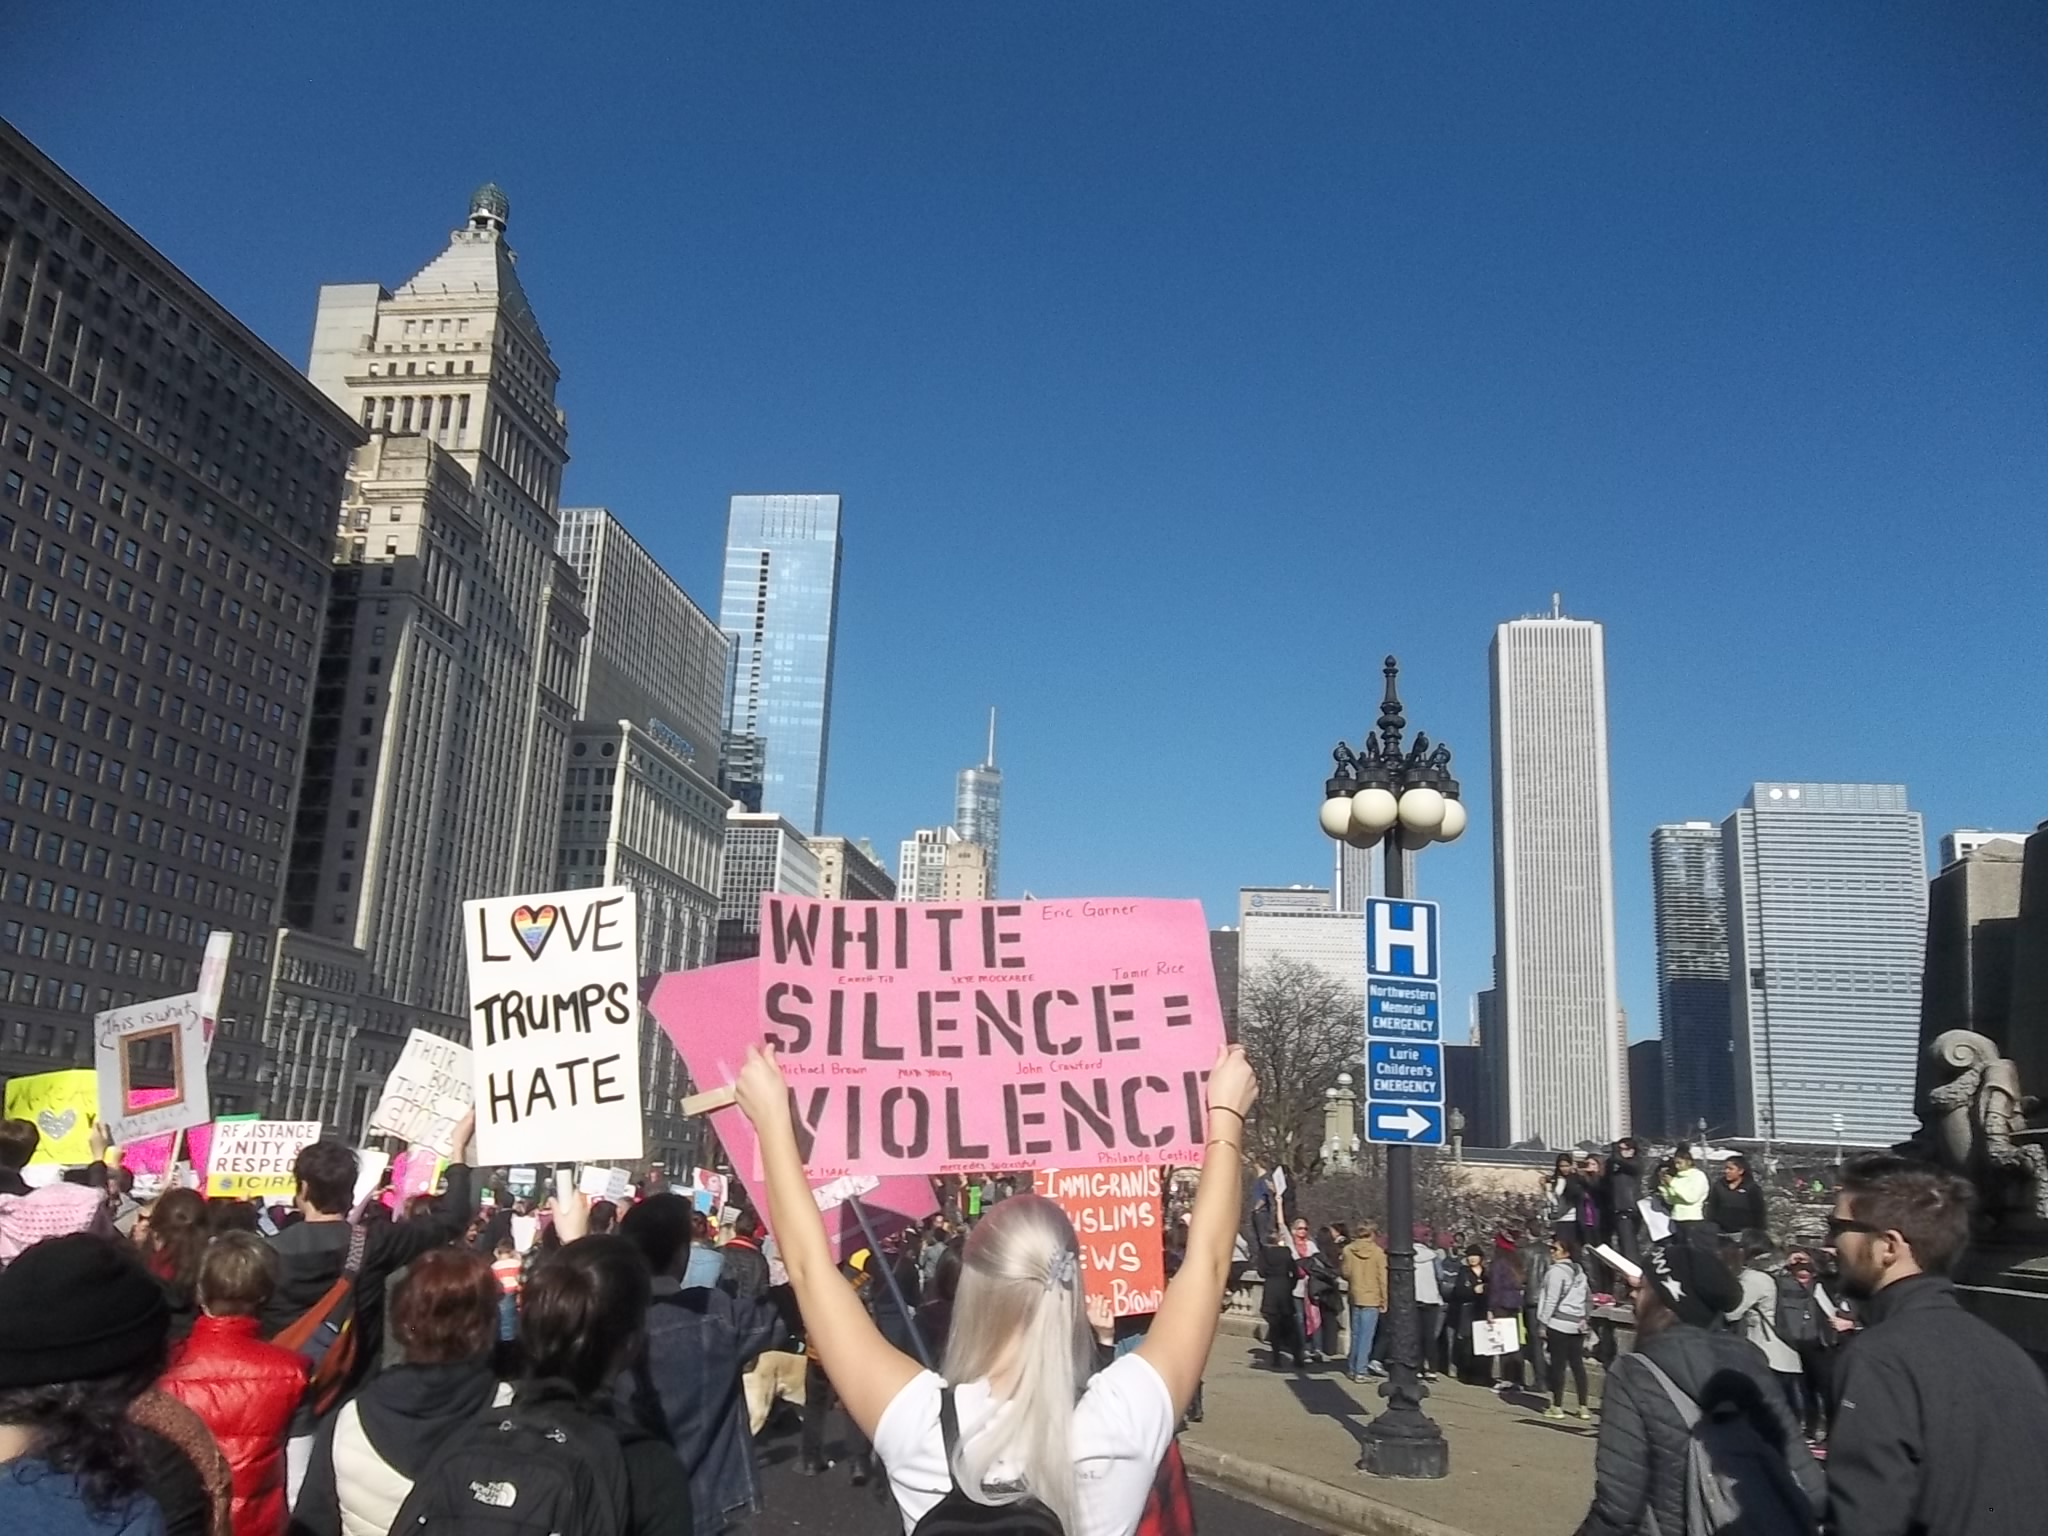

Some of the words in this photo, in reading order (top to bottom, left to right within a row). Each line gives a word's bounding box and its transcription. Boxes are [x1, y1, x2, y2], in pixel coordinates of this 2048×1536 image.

[1042, 904, 1073, 921] Eric
[1082, 901, 1139, 917] Garner
[770, 899, 1026, 971] WHITE
[1375, 902, 1429, 976] H
[1112, 966, 1150, 980] Tamir
[1156, 961, 1185, 976] Rice
[1369, 984, 1437, 1001] Northwestern
[474, 982, 631, 1047] TRUMPS
[1381, 1000, 1426, 1016] Memorial
[764, 982, 1141, 1061] SILENCE
[1372, 1016, 1434, 1032] EMERGENCY
[1389, 1047, 1420, 1061] Lurie
[778, 1062, 825, 1075] Michael
[831, 1062, 868, 1076] Brown
[1016, 1062, 1043, 1076] John
[1049, 1058, 1103, 1073] Crawford
[1376, 1062, 1434, 1077] Children's
[488, 1053, 625, 1125] HATE
[1373, 1078, 1437, 1094] EMERGENCY
[1158, 1148, 1200, 1162] Castile
[215, 1157, 296, 1173] RESPEC
[1061, 1201, 1156, 1234] USLIMS
[1079, 1241, 1141, 1272] EWS
